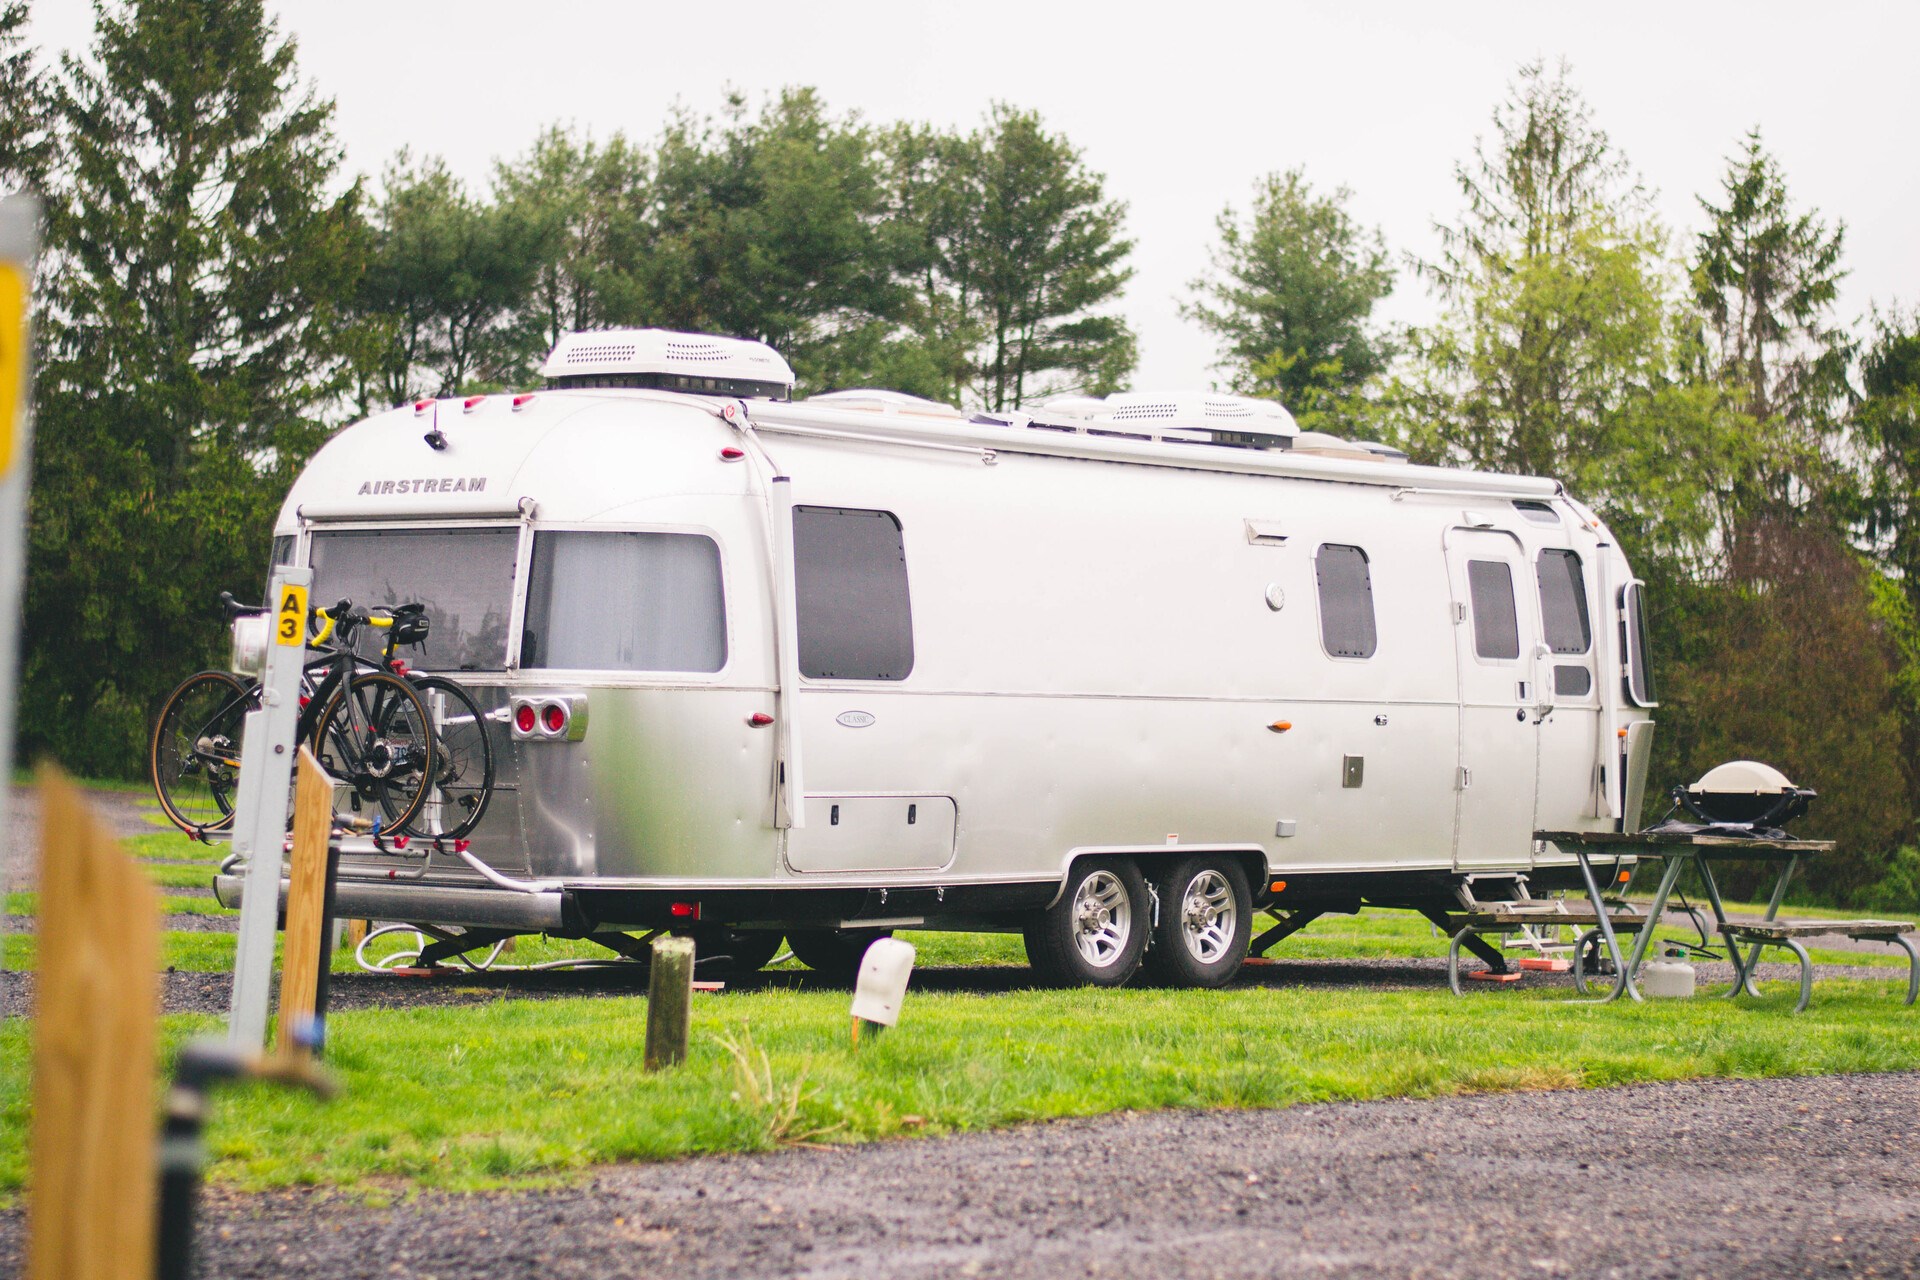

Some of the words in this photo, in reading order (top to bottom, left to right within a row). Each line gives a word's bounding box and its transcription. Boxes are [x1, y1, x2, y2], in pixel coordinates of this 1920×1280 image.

[358, 477, 487, 495] AIRSTREAM
[281, 594, 301, 614] A
[281, 618, 297, 639] 3
[843, 714, 870, 724] CLASSIC
